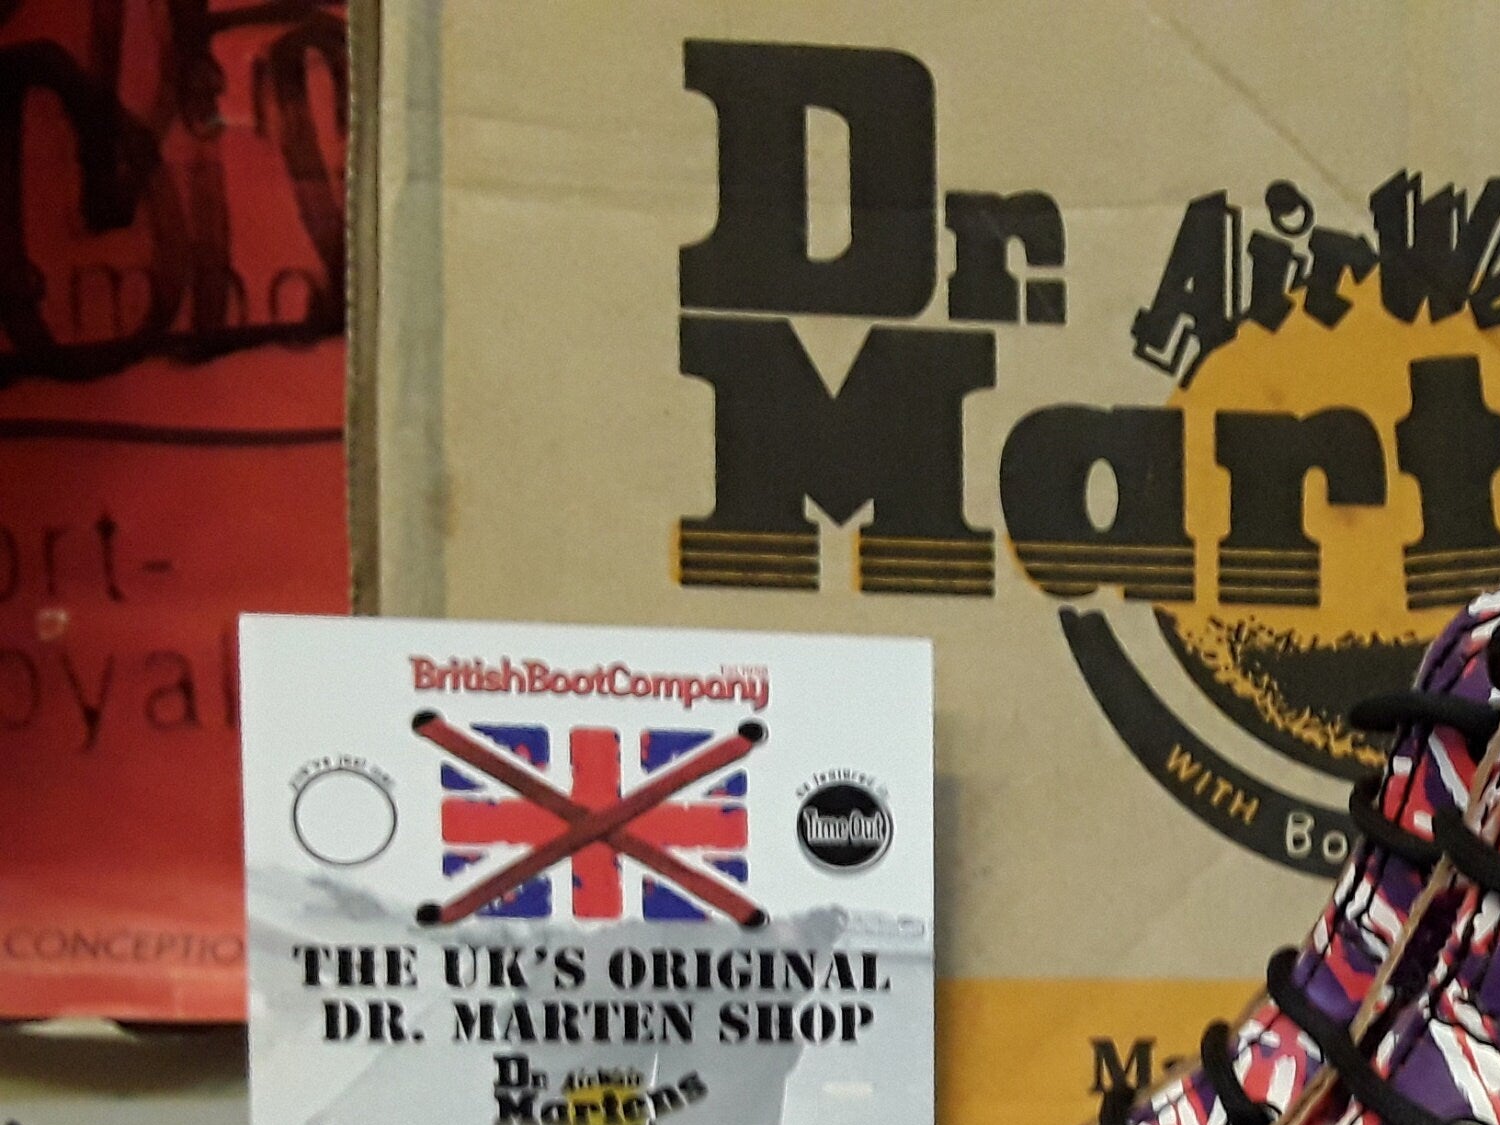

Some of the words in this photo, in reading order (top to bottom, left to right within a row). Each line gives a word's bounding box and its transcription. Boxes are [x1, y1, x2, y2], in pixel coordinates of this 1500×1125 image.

[1164, 743, 1262, 825] WITH
[293, 945, 419, 987] THE
[443, 945, 587, 989] UK'S
[608, 946, 892, 992] ORIGINAL
[323, 999, 425, 1041] DR.
[453, 999, 695, 1044] MARTEN
[718, 1001, 875, 1043] SHOP
